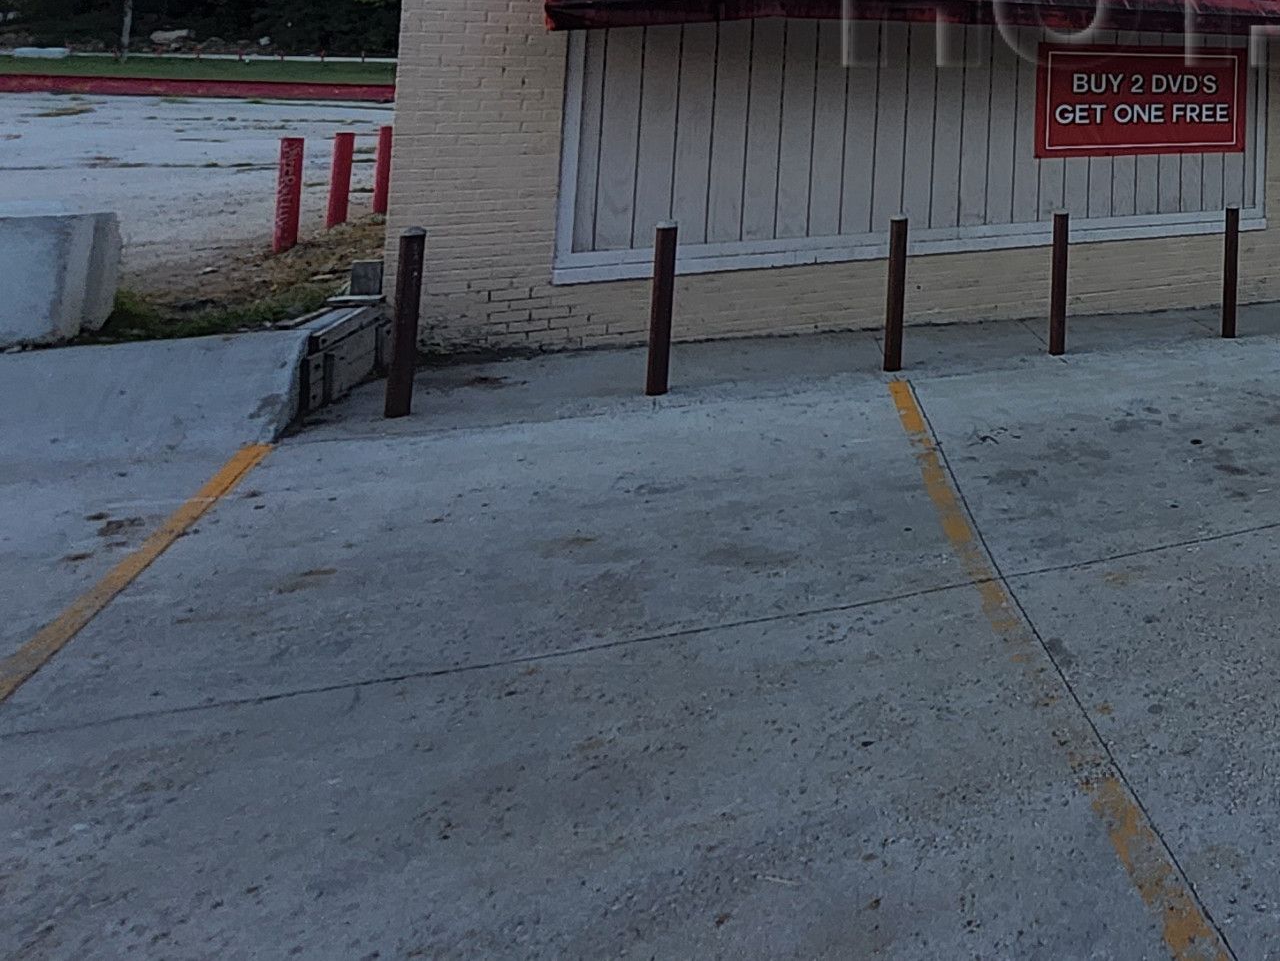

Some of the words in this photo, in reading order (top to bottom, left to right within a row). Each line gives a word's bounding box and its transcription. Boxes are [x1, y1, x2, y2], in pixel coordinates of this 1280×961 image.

[1072, 73, 1124, 94] BUY
[1130, 74, 1144, 94] 2
[1151, 74, 1217, 94] DVD'S
[1055, 104, 1107, 124] GET
[1114, 104, 1164, 123] ONE
[1172, 103, 1229, 123] FREE
